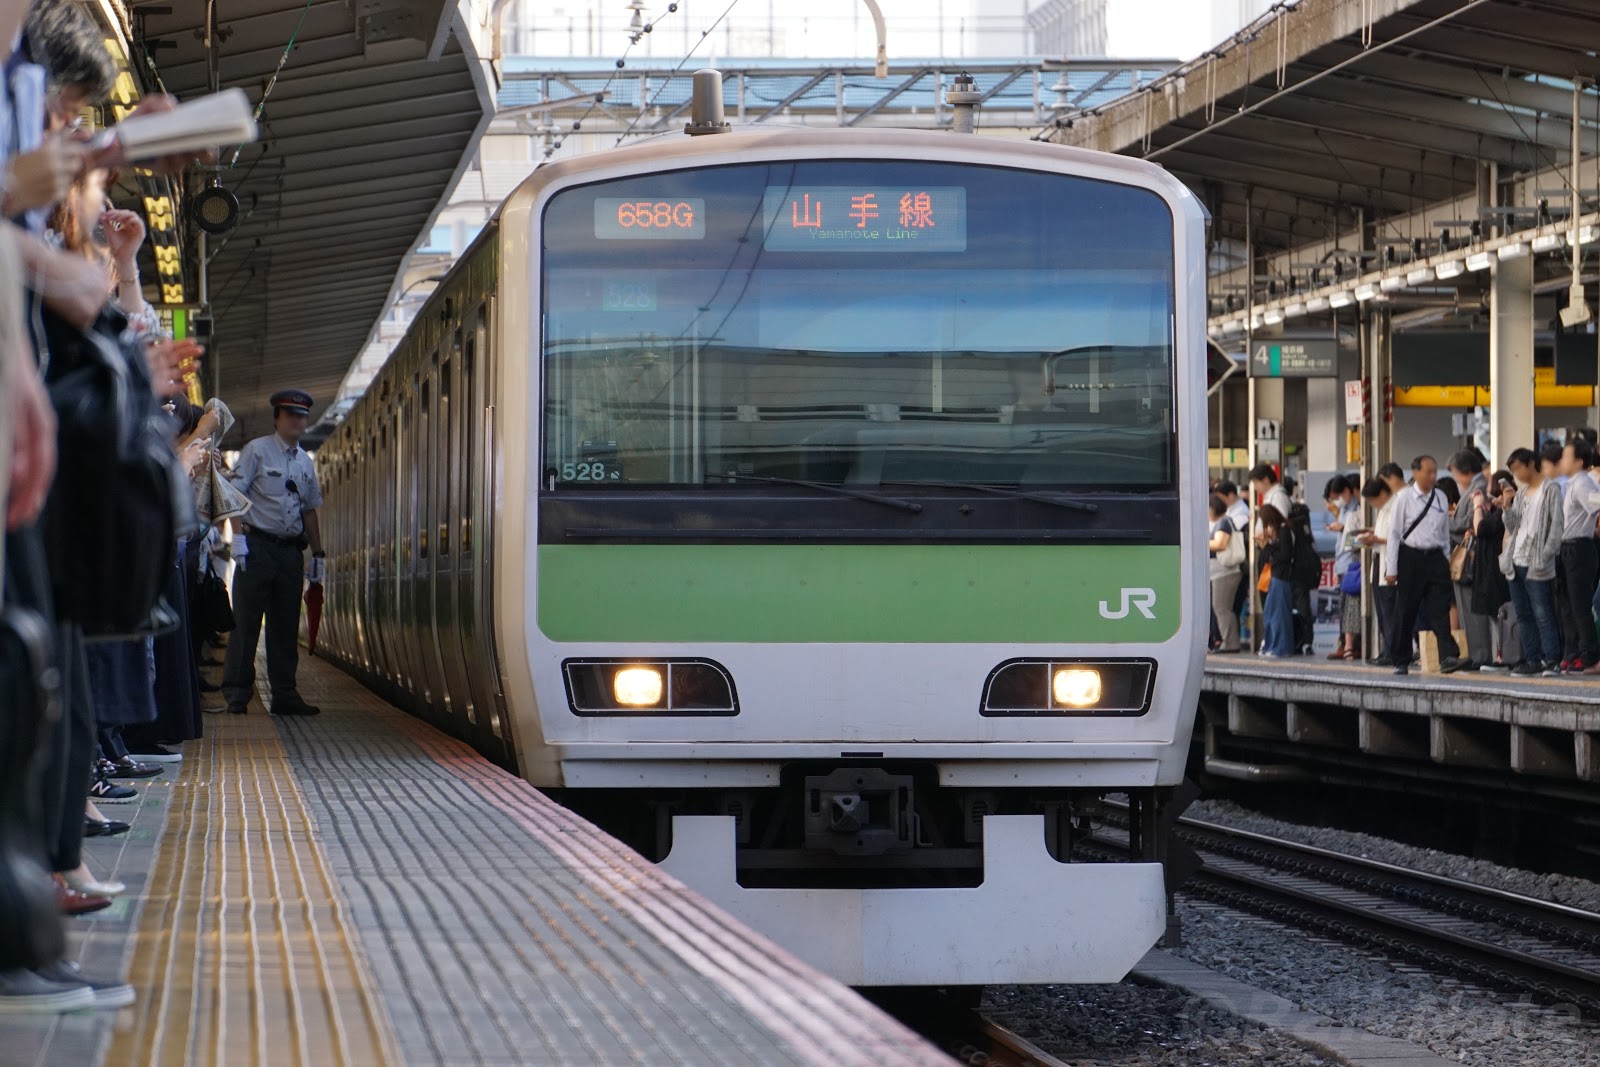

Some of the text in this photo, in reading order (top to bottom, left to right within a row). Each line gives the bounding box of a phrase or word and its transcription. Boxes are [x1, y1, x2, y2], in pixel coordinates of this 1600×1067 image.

[618, 202, 693, 228] 658G
[792, 192, 935, 228] 山手線
[809, 228, 919, 239] Yamanote Line
[1254, 345, 1269, 365] 4
[562, 462, 605, 481] 528
[1098, 587, 1157, 619] JR
[91, 780, 111, 795] N
